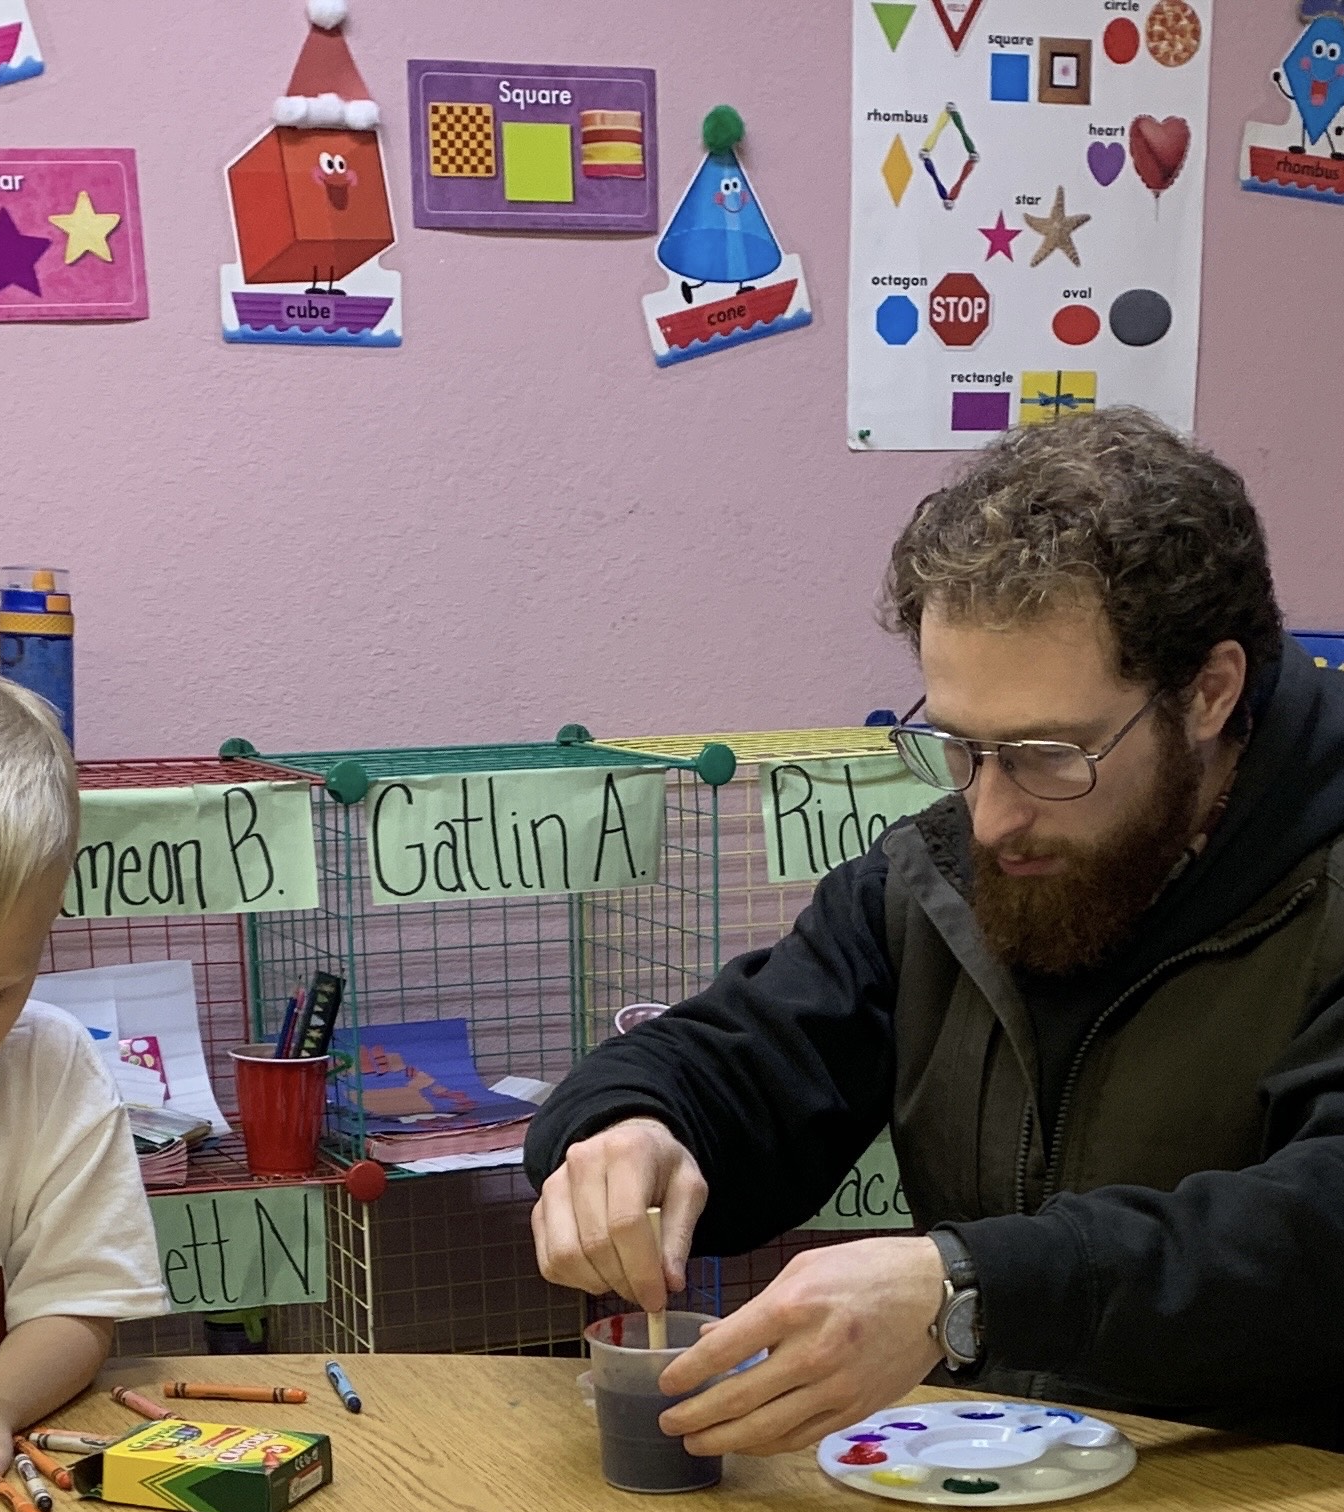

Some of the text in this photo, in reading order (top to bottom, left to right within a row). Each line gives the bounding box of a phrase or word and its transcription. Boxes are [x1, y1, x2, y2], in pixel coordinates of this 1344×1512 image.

[988, 34, 1034, 47] square
[498, 80, 572, 110] Square
[866, 108, 929, 124] rhombus
[1088, 123, 1125, 137] heart
[1276, 156, 1340, 180] rhombus
[1015, 193, 1042, 206] star
[871, 274, 928, 290] octagon
[1063, 287, 1092, 299] oval
[286, 300, 331, 319] cube
[707, 304, 746, 326] cone
[932, 296, 986, 323] STOP
[950, 371, 1013, 386] rectangle
[372, 772, 647, 897] Gatlin A.
[59, 786, 285, 918] meon B.
[254, 1192, 317, 1299] N.
